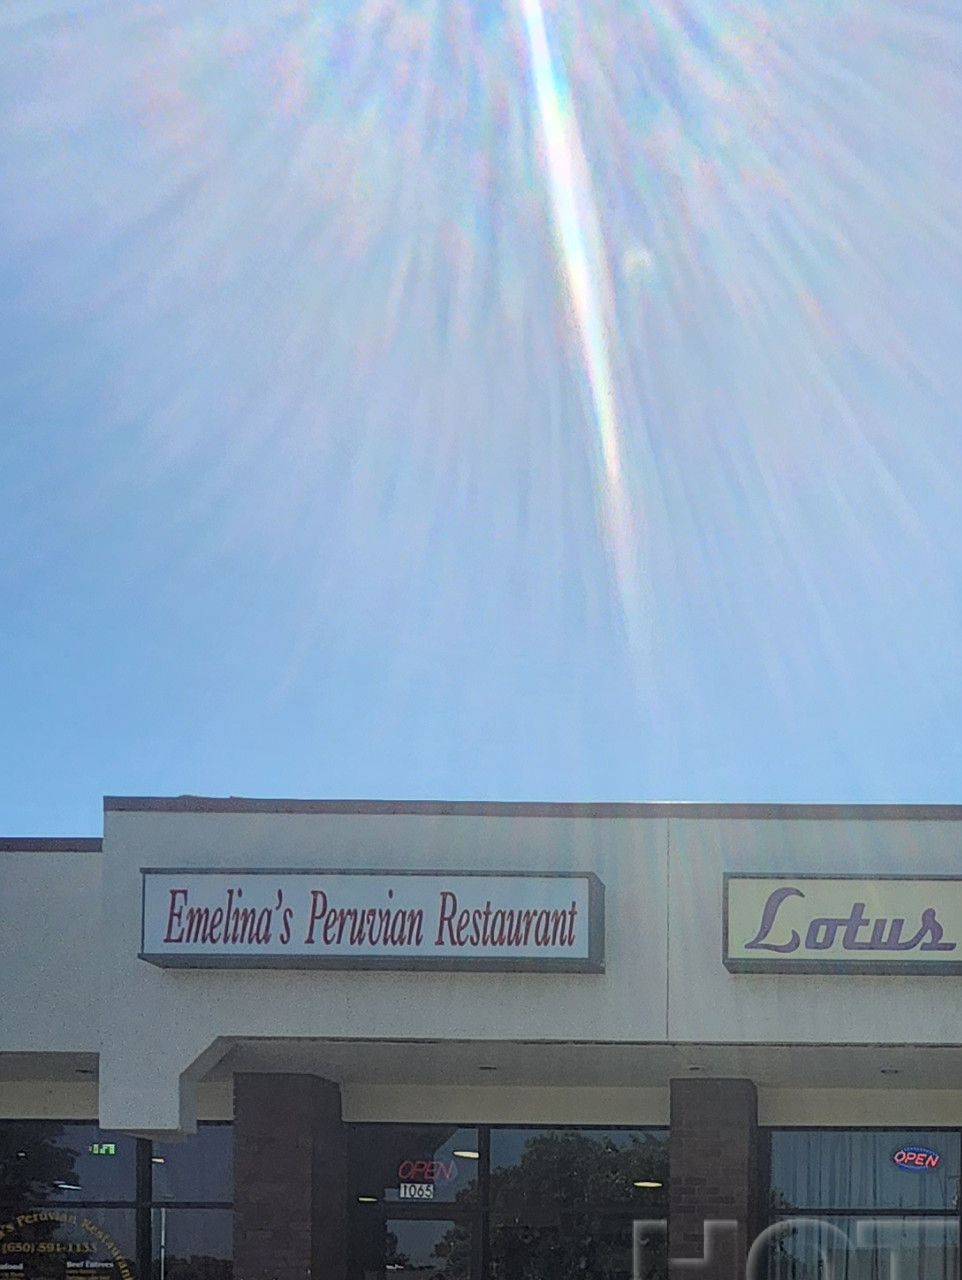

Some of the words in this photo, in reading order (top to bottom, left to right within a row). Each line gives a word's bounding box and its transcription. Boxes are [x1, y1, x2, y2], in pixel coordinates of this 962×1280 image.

[163, 888, 294, 945] Emelina's
[304, 889, 423, 947] Peruvian
[434, 891, 578, 948] Restaurant
[744, 886, 957, 954] Lotus
[894, 1150, 939, 1168] OPEN
[399, 1160, 453, 1180] OPEN
[402, 1184, 433, 1198] 1065
[16, 1210, 77, 1227] Peruvian
[2, 1242, 35, 1254] (650)
